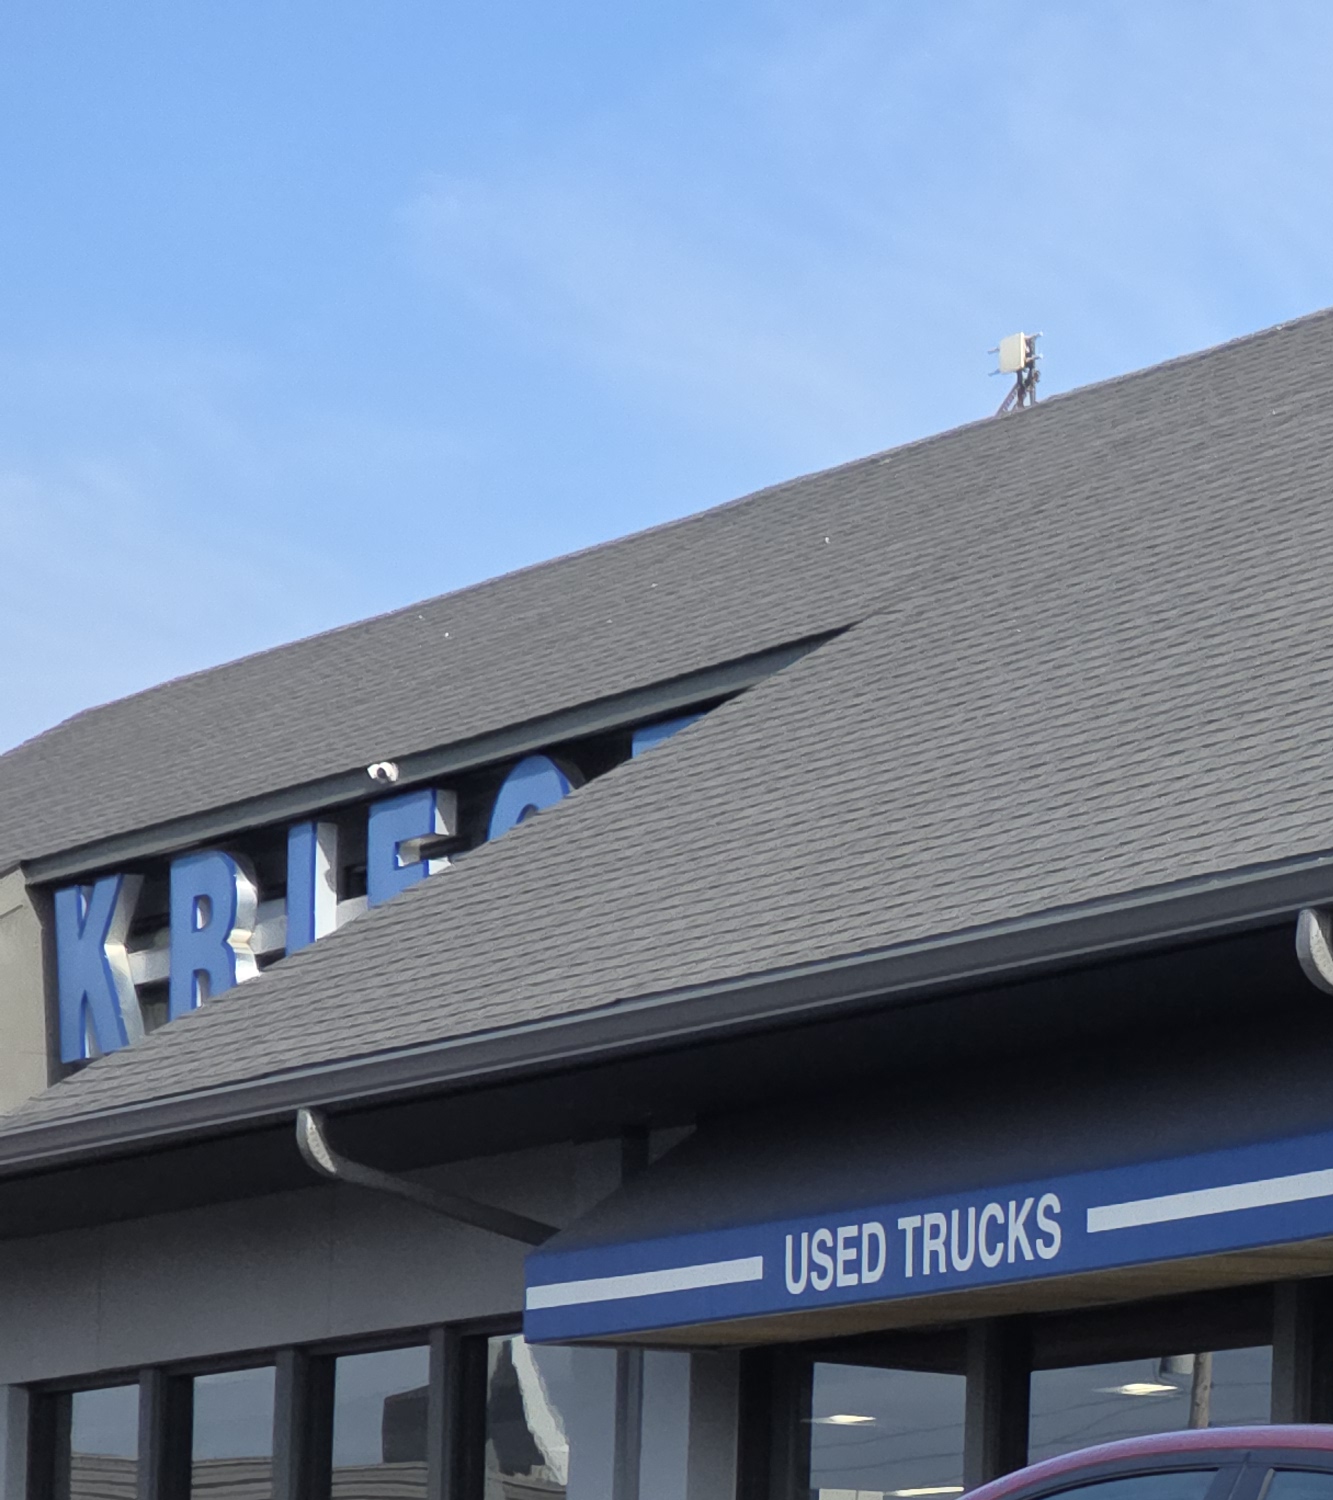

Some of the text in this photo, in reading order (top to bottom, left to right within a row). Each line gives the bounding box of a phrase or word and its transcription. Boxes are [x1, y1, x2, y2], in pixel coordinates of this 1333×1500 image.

[55, 713, 705, 1063] KRIE
[785, 1193, 1062, 1295] USED TRUCKS
